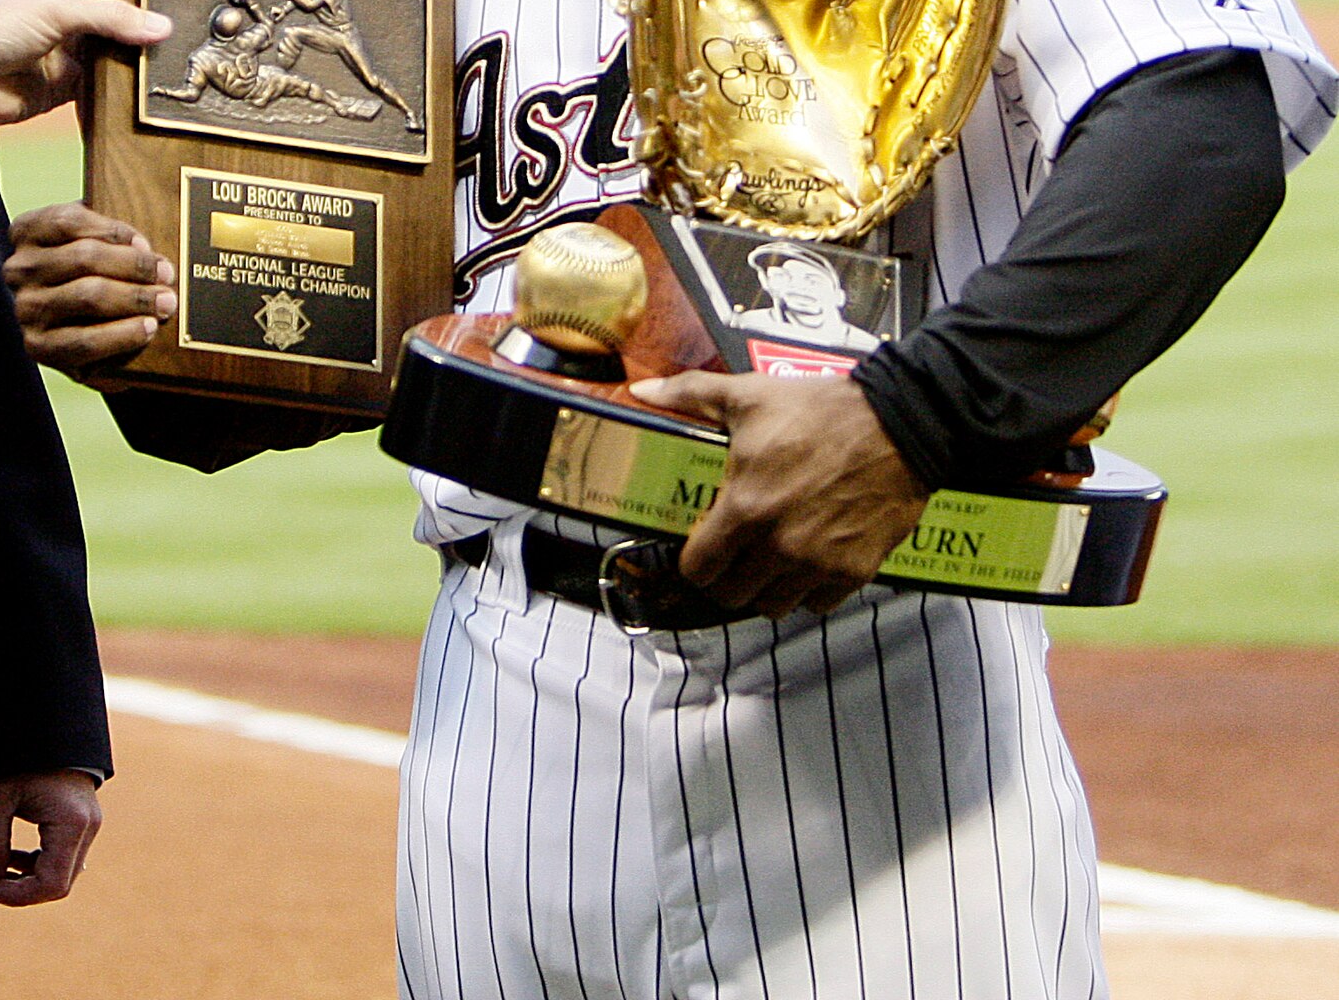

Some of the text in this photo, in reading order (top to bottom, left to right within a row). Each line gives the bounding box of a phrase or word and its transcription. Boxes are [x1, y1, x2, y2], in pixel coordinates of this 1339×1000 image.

[702, 36, 797, 77] GOLD
[718, 66, 817, 107] GLOVE
[454, 30, 639, 233] Ast
[738, 102, 807, 126] Award
[212, 181, 353, 217] LOU BROCK AWARD
[244, 206, 322, 226] PRESENTED TO
[193, 263, 370, 300] BASE STEALING CHAMPION
[219, 252, 345, 282] NATIONAL LEAGUE
